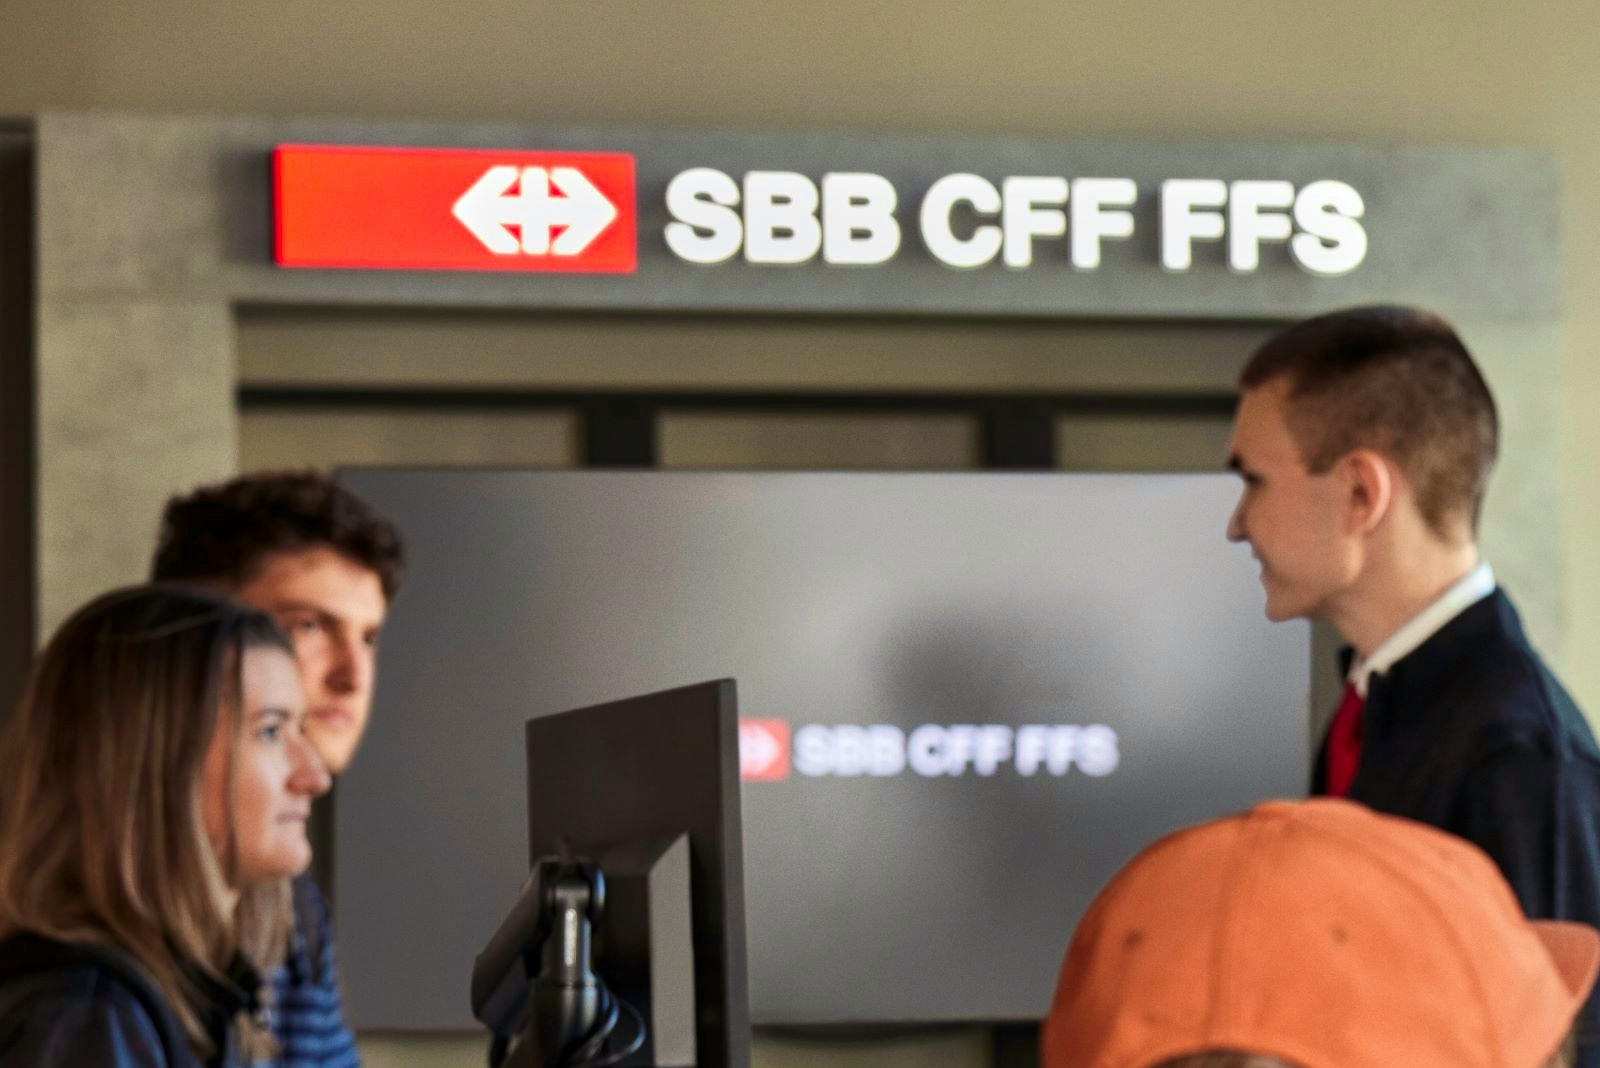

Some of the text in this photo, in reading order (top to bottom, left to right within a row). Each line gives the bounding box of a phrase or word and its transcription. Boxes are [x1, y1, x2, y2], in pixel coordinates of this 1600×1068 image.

[664, 166, 1367, 275] SBB CFF FFS
[794, 723, 1120, 778] SBB CFF FFS
